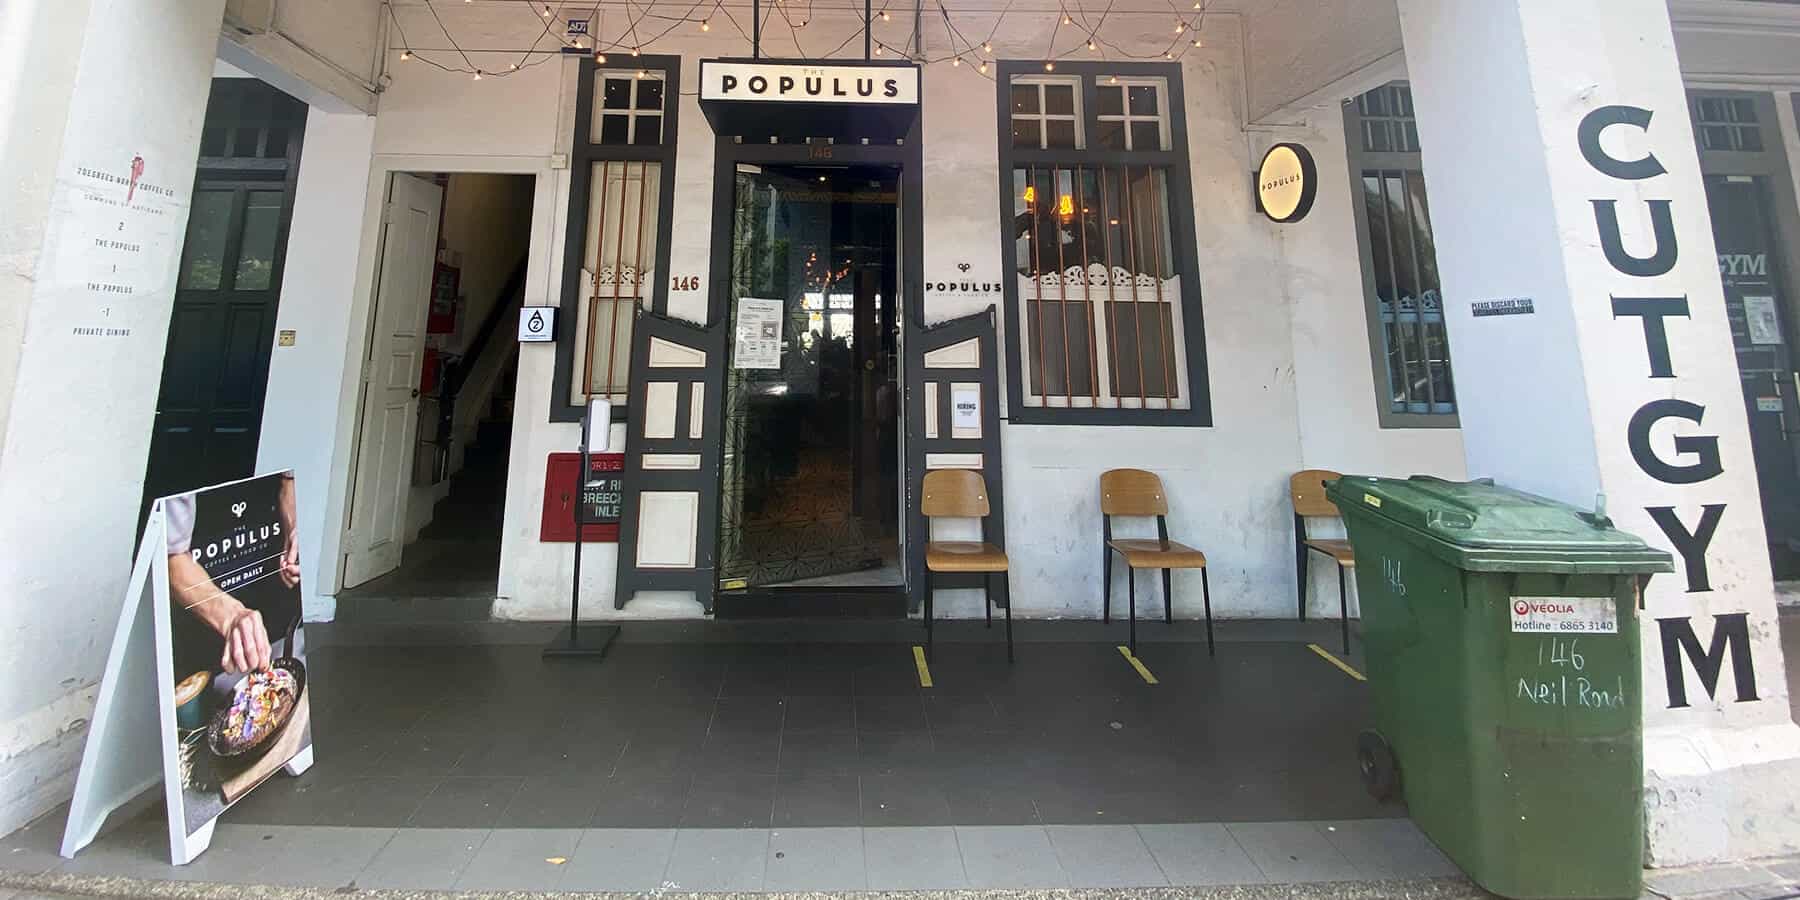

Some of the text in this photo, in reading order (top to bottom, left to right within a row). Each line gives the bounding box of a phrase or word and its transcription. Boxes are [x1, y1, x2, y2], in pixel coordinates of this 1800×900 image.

[721, 75, 898, 97] POPULUS
[1262, 173, 1300, 191] POPULUS
[139, 183, 163, 195] COFFEE
[118, 221, 124, 231] 2
[95, 238, 140, 252] THE POPULUS
[87, 282, 133, 294] THE POPULUS
[672, 276, 699, 291] 146
[926, 282, 1001, 292] POPULUS
[73, 327, 131, 337] PRIVATE DINING
[594, 505, 621, 517] INLE
[191, 522, 281, 563] POPULUS
[220, 566, 263, 588] OPEN DAILY
[1531, 604, 1574, 613] VEOLIA
[1514, 620, 1551, 630] Hotline
[1560, 621, 1585, 630] 6865
[1588, 621, 1613, 630] 3140
[1539, 637, 1585, 670] 146
[1518, 675, 1624, 708] Neil Road
